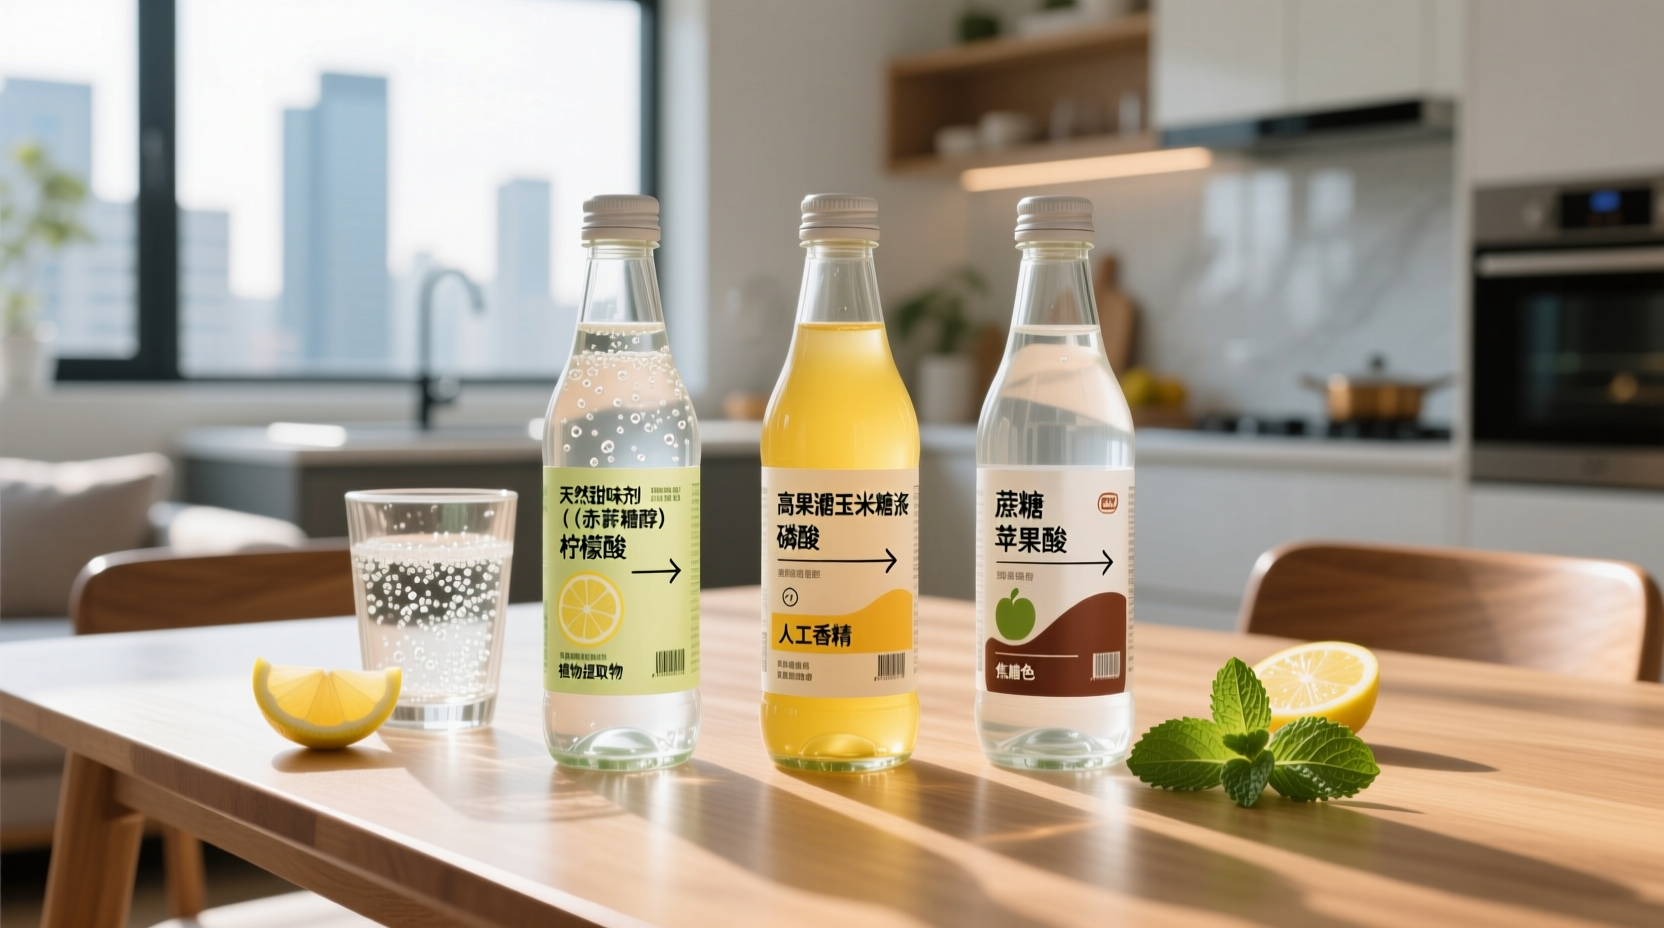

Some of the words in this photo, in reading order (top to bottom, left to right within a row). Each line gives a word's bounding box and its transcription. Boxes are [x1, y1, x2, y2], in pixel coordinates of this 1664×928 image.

[995, 489, 1045, 520] 蔗糖
[559, 533, 627, 560] 柠檬酸
[776, 523, 820, 551] 磷酸
[994, 524, 1068, 554] 苹果酸
[778, 623, 852, 648] 人工香精
